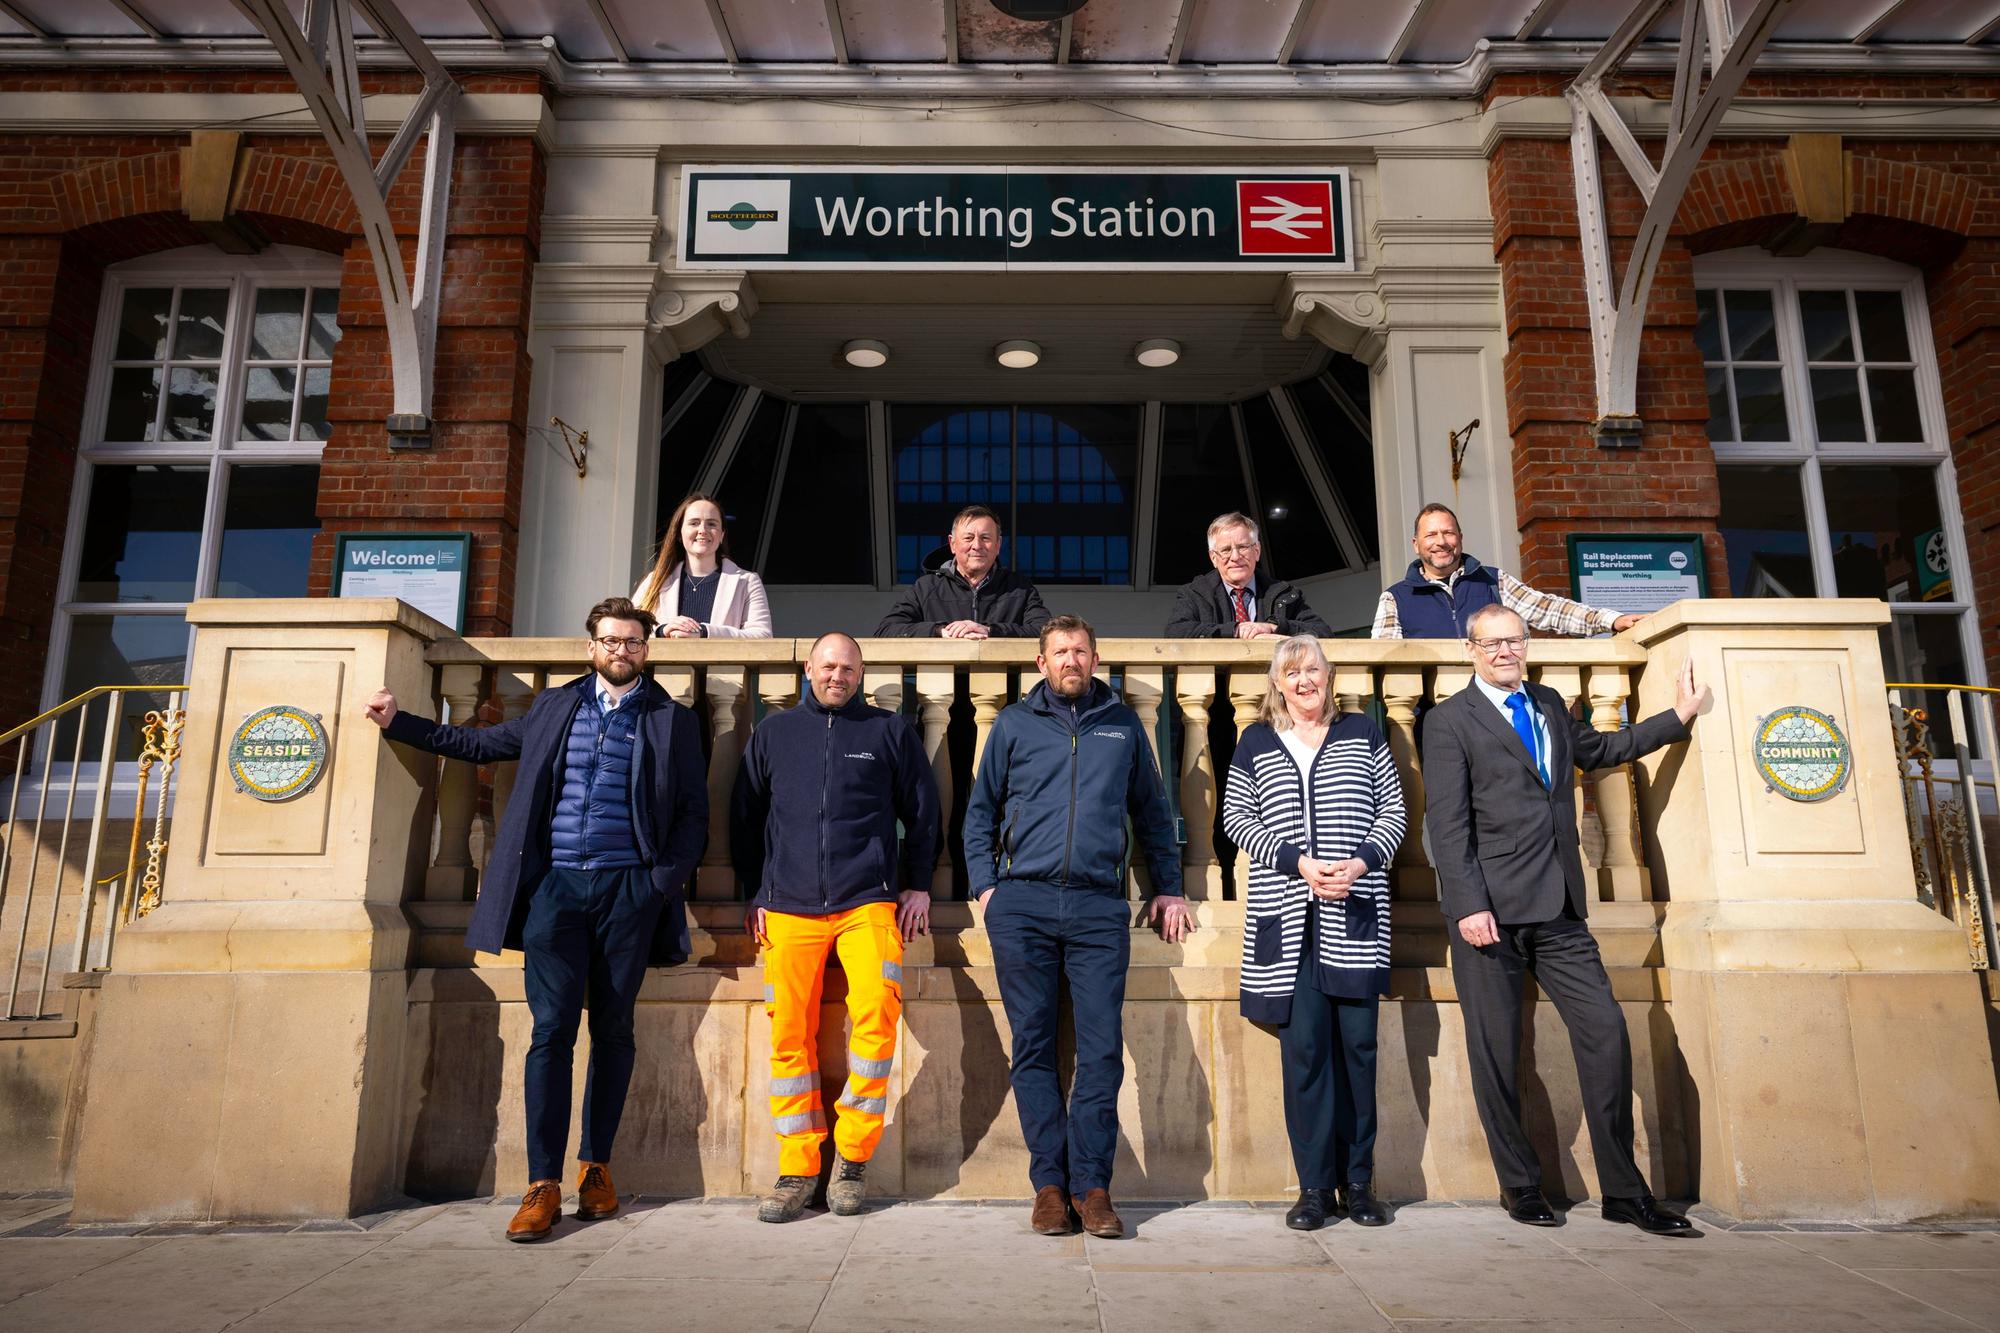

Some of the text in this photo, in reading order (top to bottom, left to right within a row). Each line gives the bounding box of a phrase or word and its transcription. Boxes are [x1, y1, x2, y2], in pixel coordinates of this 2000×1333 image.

[815, 196, 1216, 248] Worthing Station
[352, 550, 435, 565] Welcome
[1600, 553, 1653, 562] Replacement
[1622, 572, 1652, 580] Worthing
[243, 744, 311, 757] SEASIDE
[1761, 747, 1842, 758] COMMUNITY
